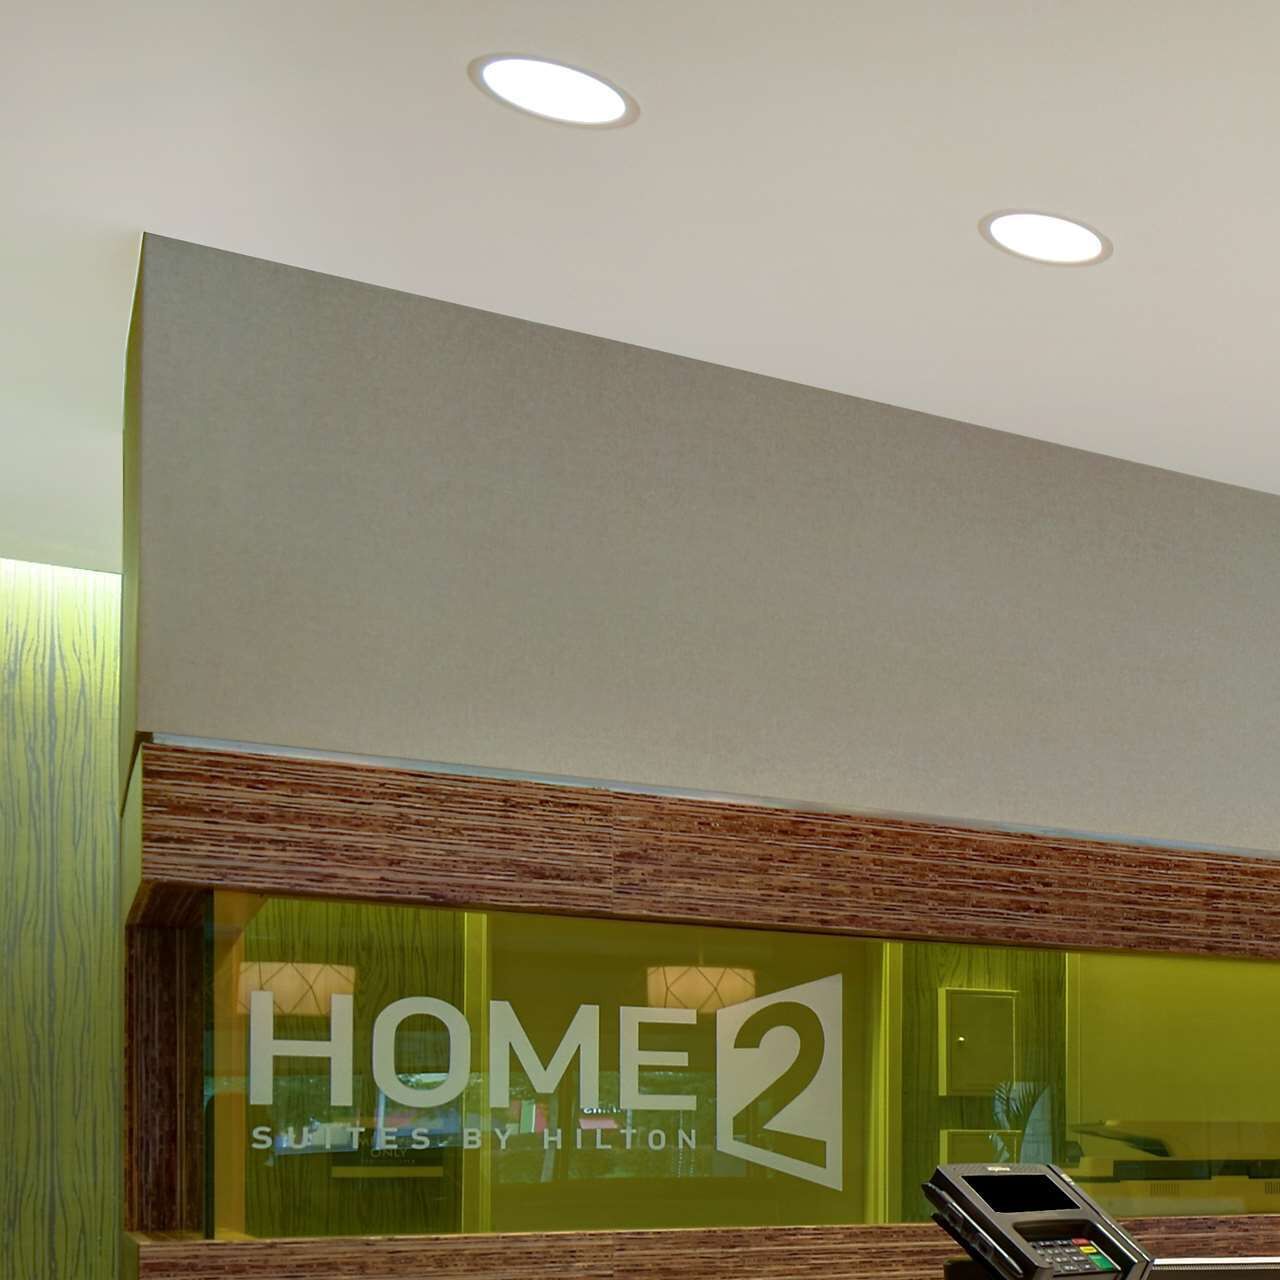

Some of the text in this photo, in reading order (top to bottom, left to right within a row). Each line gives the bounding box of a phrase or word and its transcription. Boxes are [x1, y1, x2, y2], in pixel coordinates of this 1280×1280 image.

[249, 990, 697, 1110] HOME
[252, 1125, 698, 1151] SUITES BY HILTON
